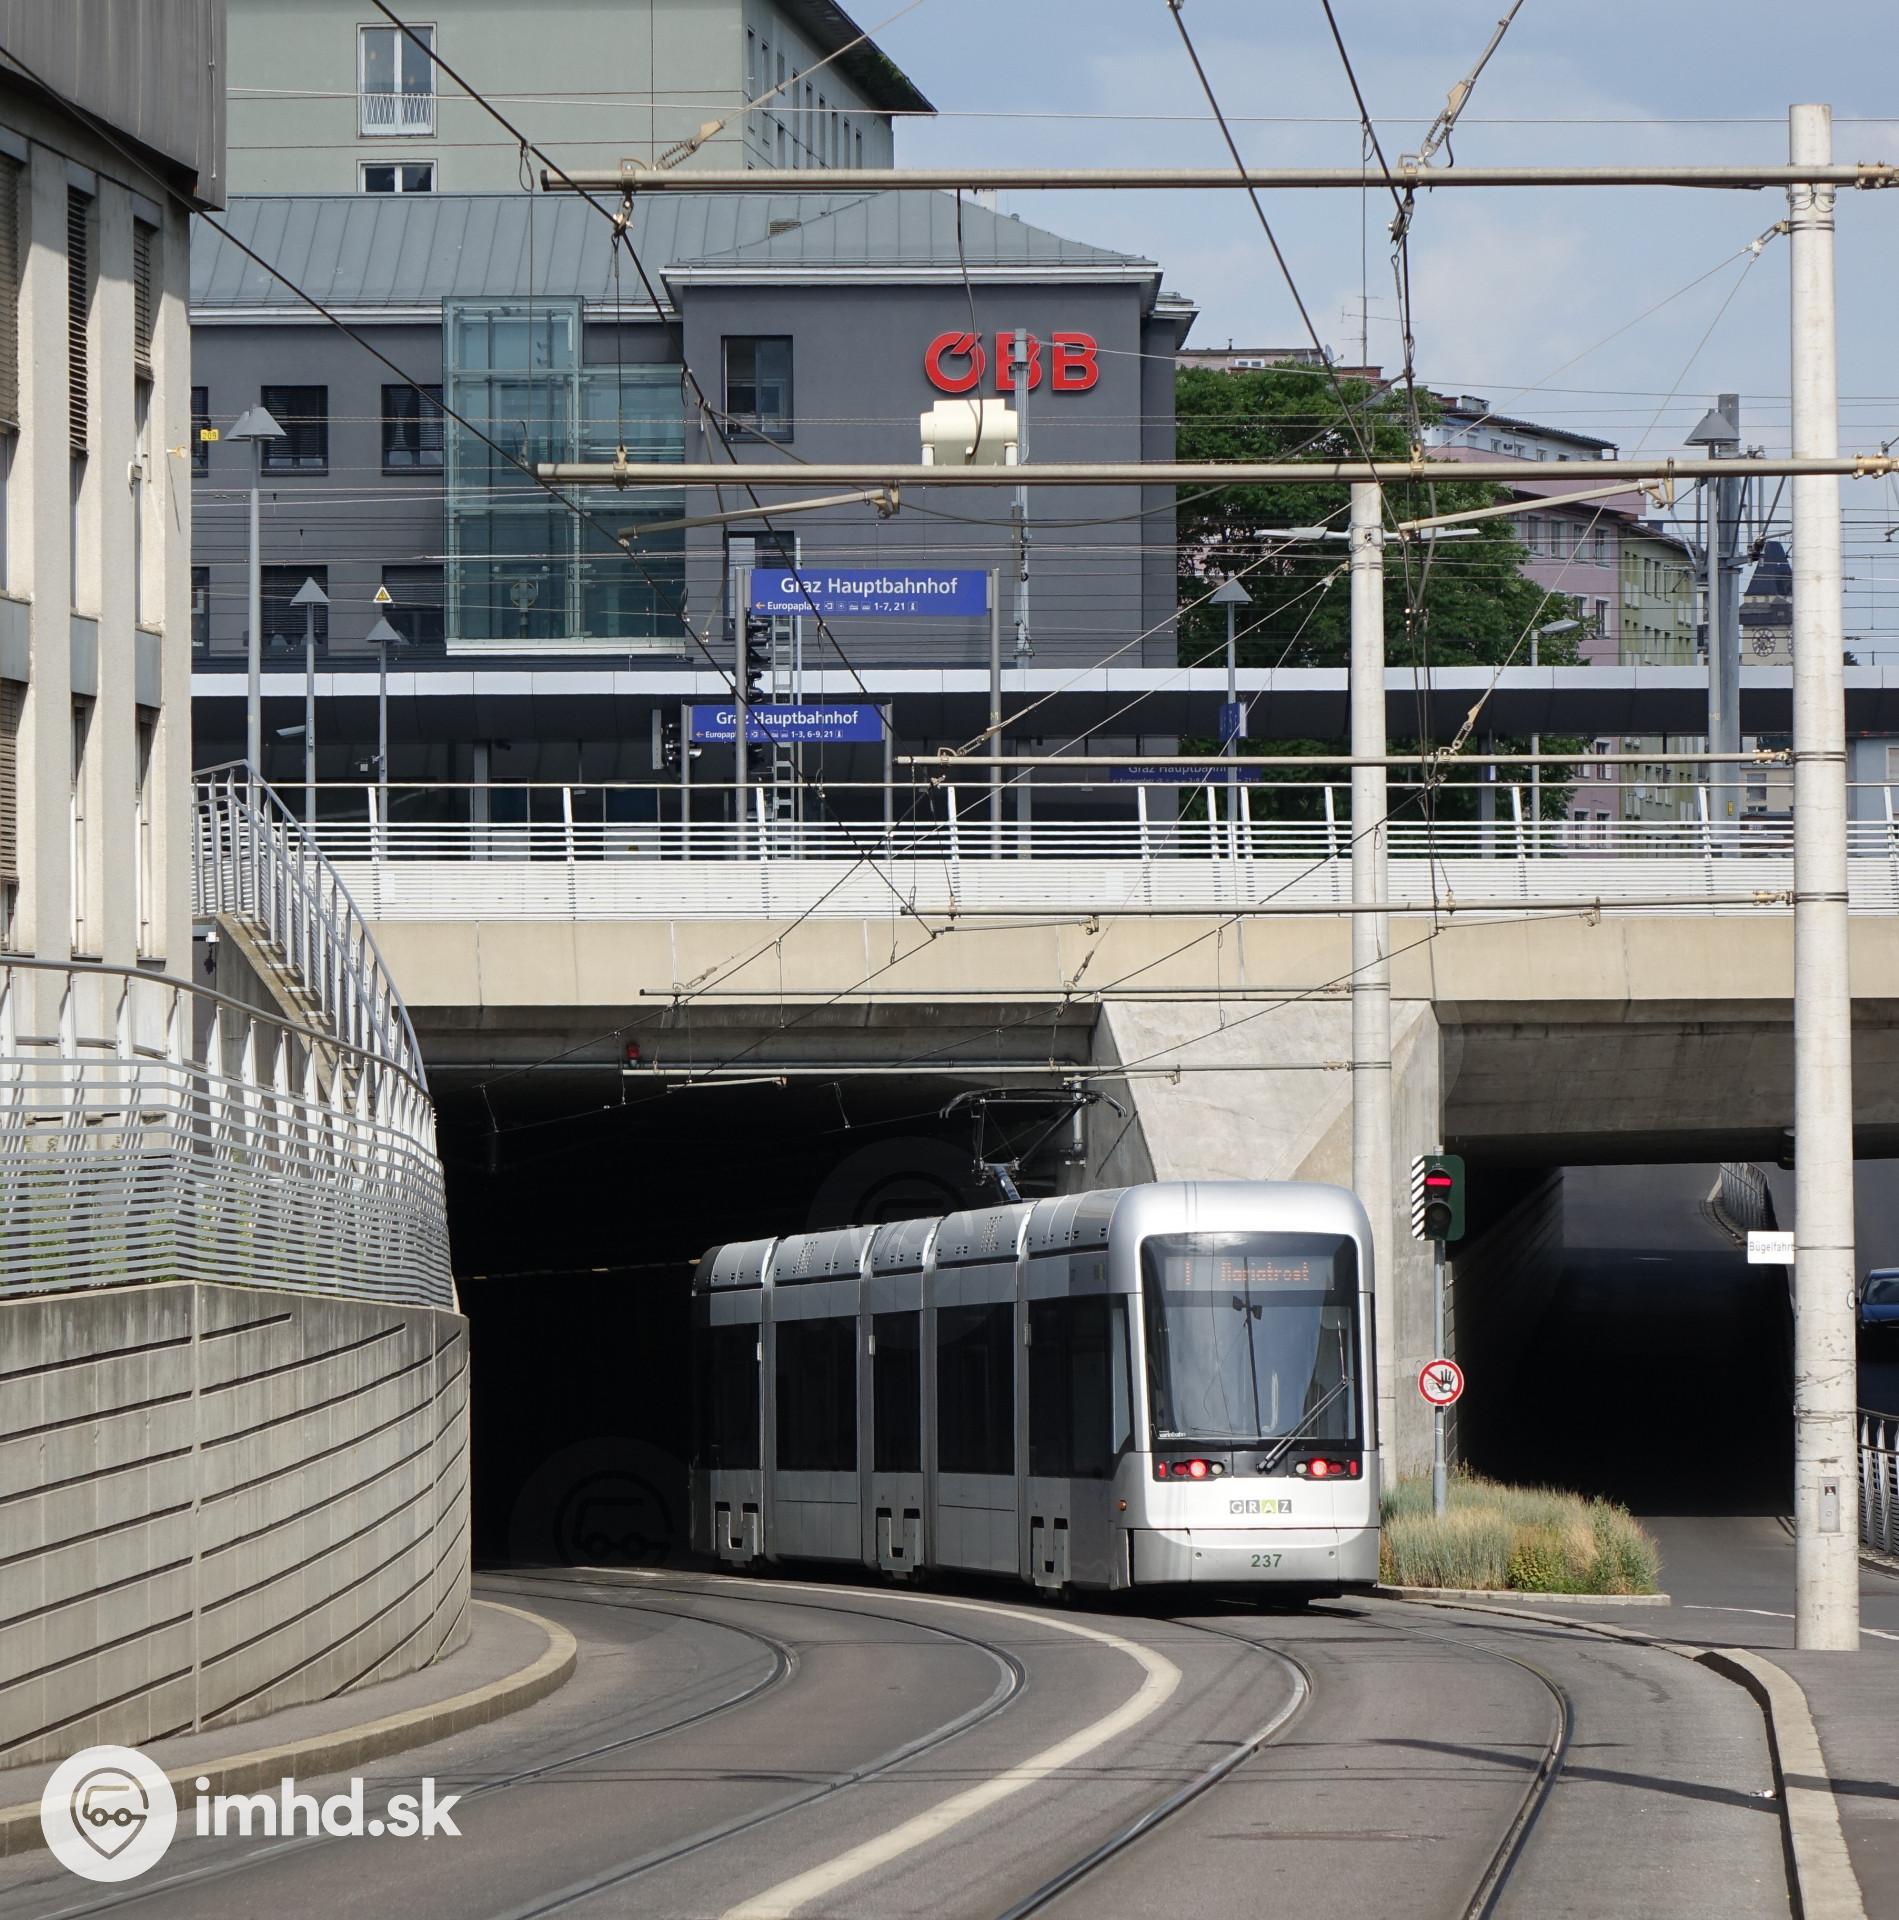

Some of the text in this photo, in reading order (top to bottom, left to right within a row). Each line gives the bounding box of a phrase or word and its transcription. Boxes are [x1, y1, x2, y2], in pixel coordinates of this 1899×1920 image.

[925, 332, 1098, 393] ÖBB
[781, 577, 958, 598] Graz Hauptbahnhof
[767, 601, 905, 612] Europaplaz 1-7, 21
[754, 710, 859, 728] Hauptbahnhof
[705, 731, 748, 740] Europap
[1230, 1500, 1292, 1514] GRAZ
[1250, 1553, 1282, 1568] 237
